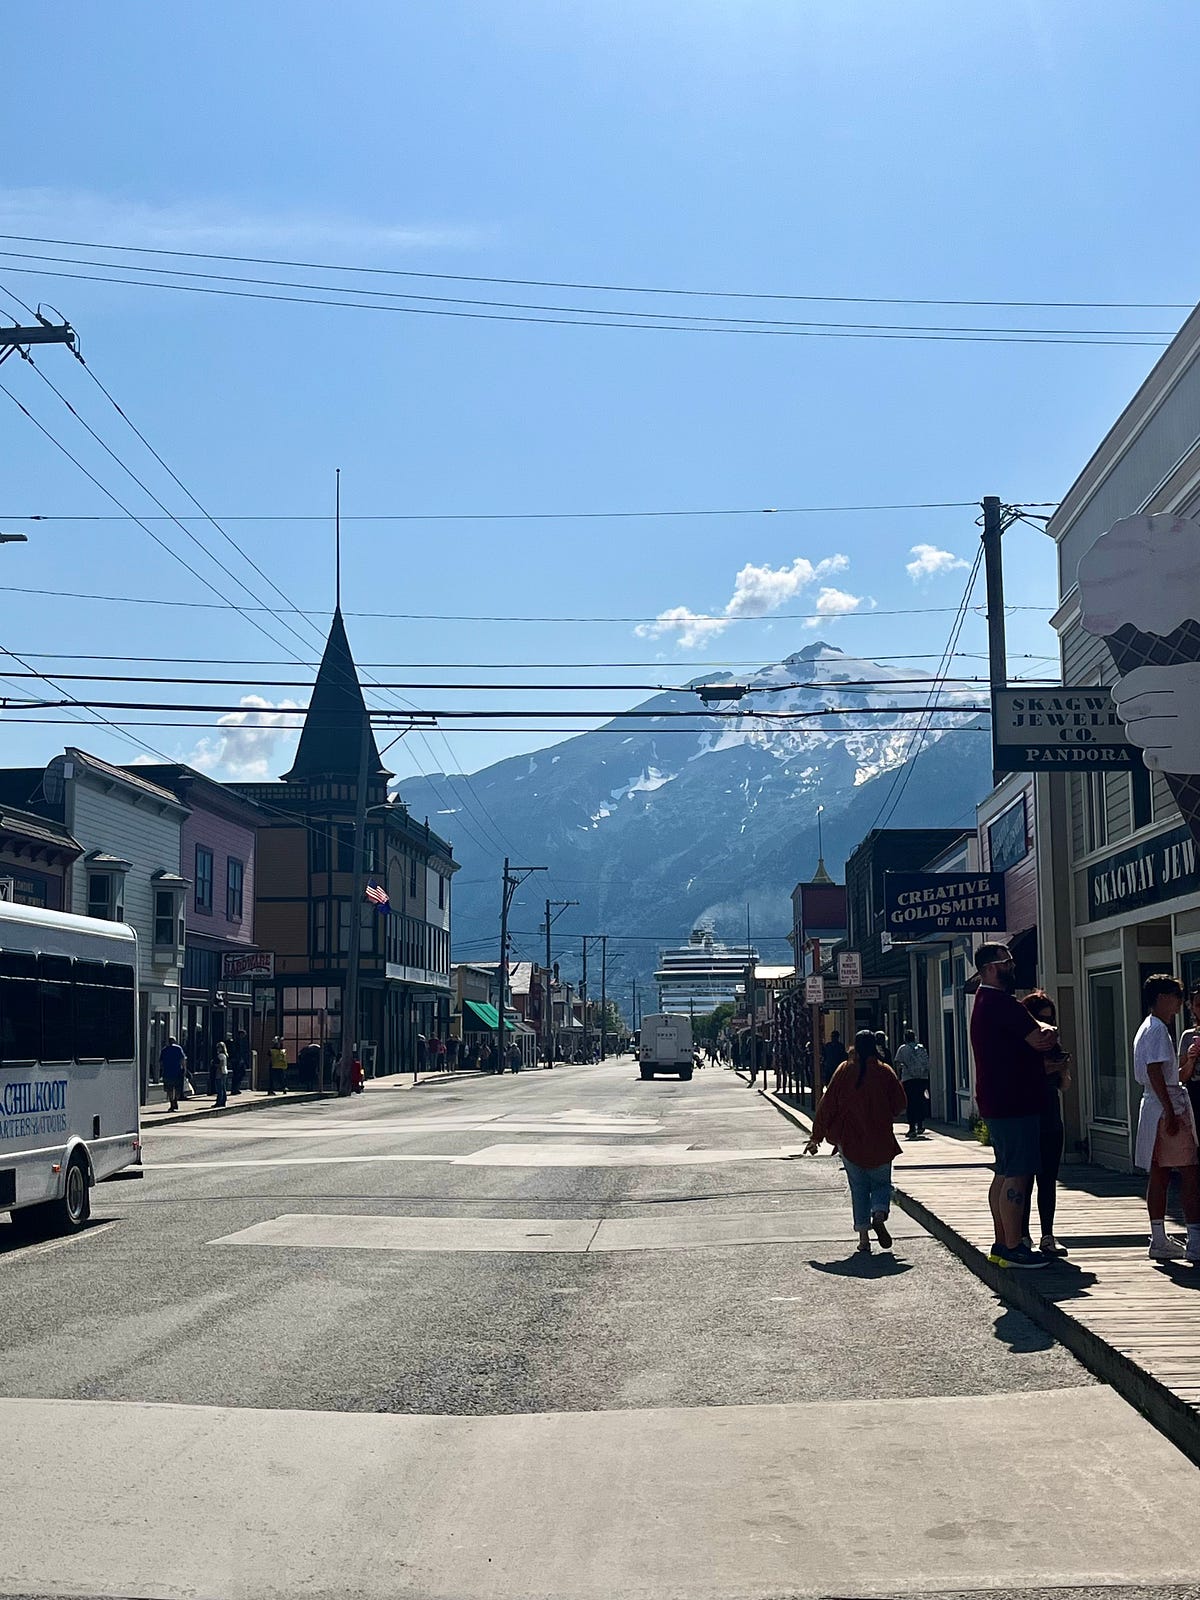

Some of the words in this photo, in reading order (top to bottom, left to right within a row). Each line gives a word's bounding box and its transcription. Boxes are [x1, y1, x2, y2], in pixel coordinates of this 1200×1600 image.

[1059, 728, 1096, 741] CO.
[1025, 748, 1131, 762] PANDORA
[1094, 853, 1155, 906] SKAGWAY
[897, 878, 990, 906] CREATIVE
[891, 893, 1000, 923] GOLDSMITH
[937, 917, 951, 926] OF
[955, 917, 998, 926] ALASKA
[224, 954, 270, 975] HARDWARE
[4, 1080, 67, 1115] CHILKOOT
